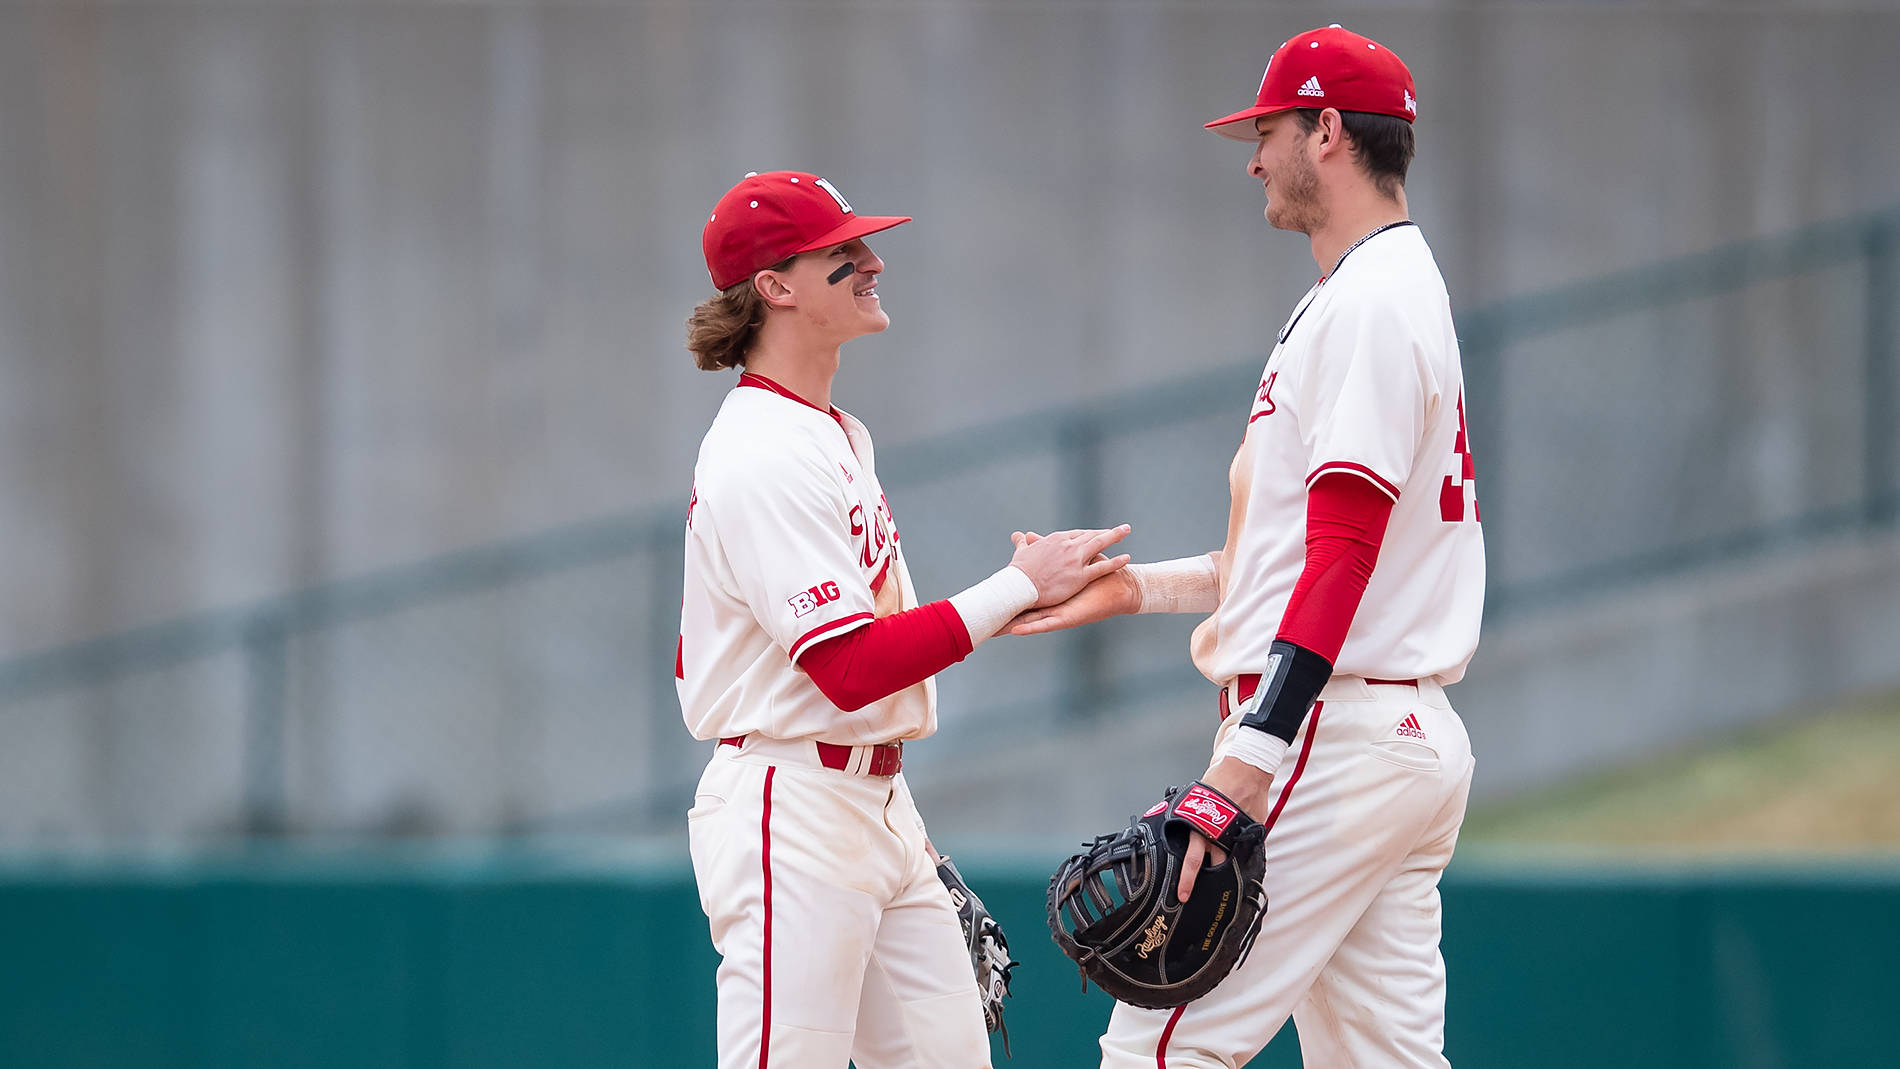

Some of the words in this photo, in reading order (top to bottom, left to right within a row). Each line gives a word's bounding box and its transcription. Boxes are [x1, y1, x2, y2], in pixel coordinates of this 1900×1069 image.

[1297, 88, 1325, 98] adidas
[1396, 726, 1427, 740] adidas
[1184, 797, 1228, 825] Rawlings
[1135, 914, 1168, 959] Rawlings
[1201, 937, 1212, 951] THE
